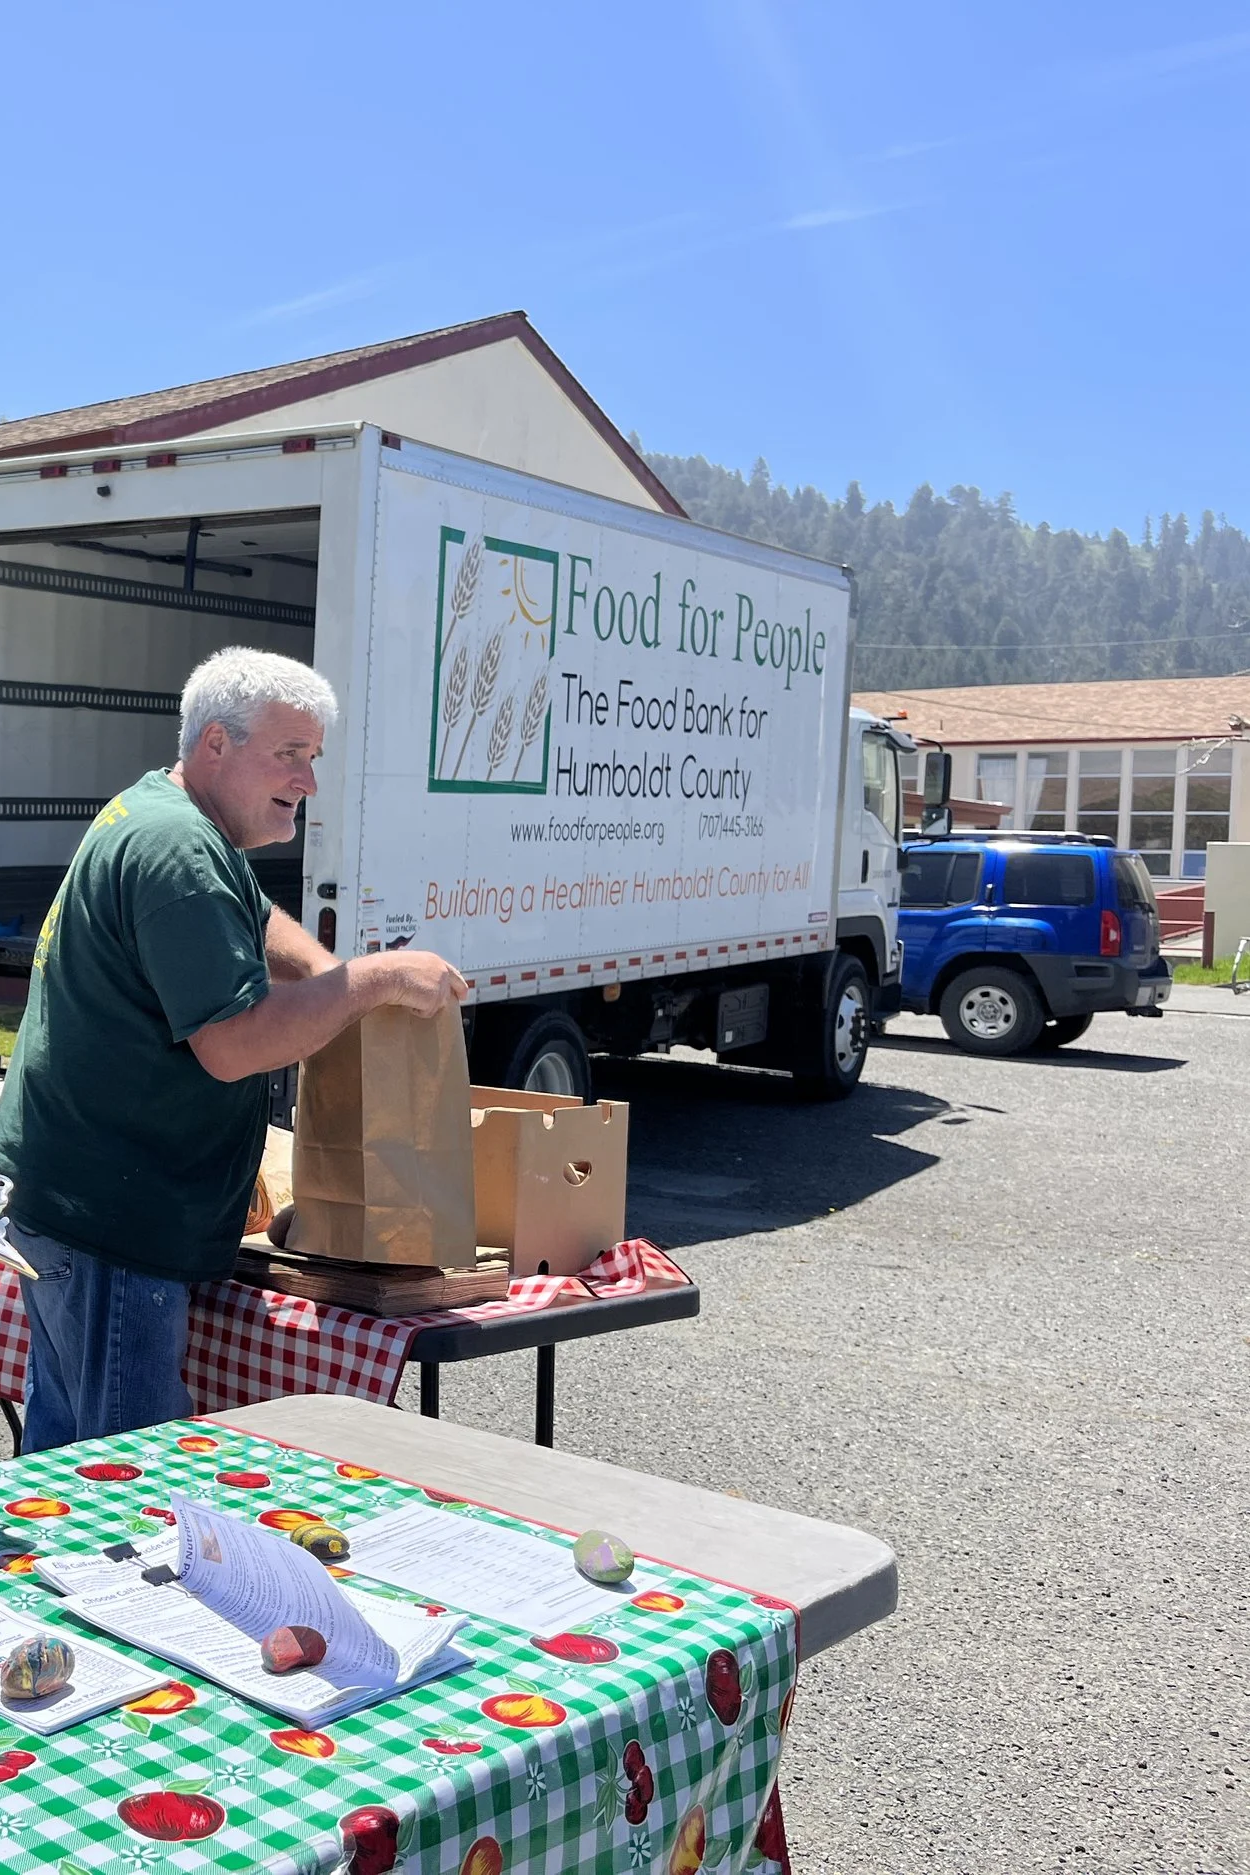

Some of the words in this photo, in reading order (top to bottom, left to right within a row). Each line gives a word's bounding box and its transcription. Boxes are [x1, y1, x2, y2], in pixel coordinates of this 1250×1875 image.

[563, 553, 661, 649] Food
[677, 579, 724, 657] for
[732, 593, 826, 690] People
[561, 672, 609, 726] The
[616, 679, 678, 731] Food
[683, 688, 733, 736] Bank
[739, 695, 768, 739] for
[555, 746, 671, 798] Humboldt
[680, 754, 751, 811] County
[511, 816, 664, 847] www.foodforpeople.org
[385, 914, 405, 923] Fueled
[425, 878, 515, 923] Building
[520, 885, 535, 912] a
[542, 873, 628, 911] Healthier
[633, 865, 714, 903] Humboldt
[717, 866, 771, 899] County
[772, 863, 791, 892] for
[792, 860, 811, 890] All
